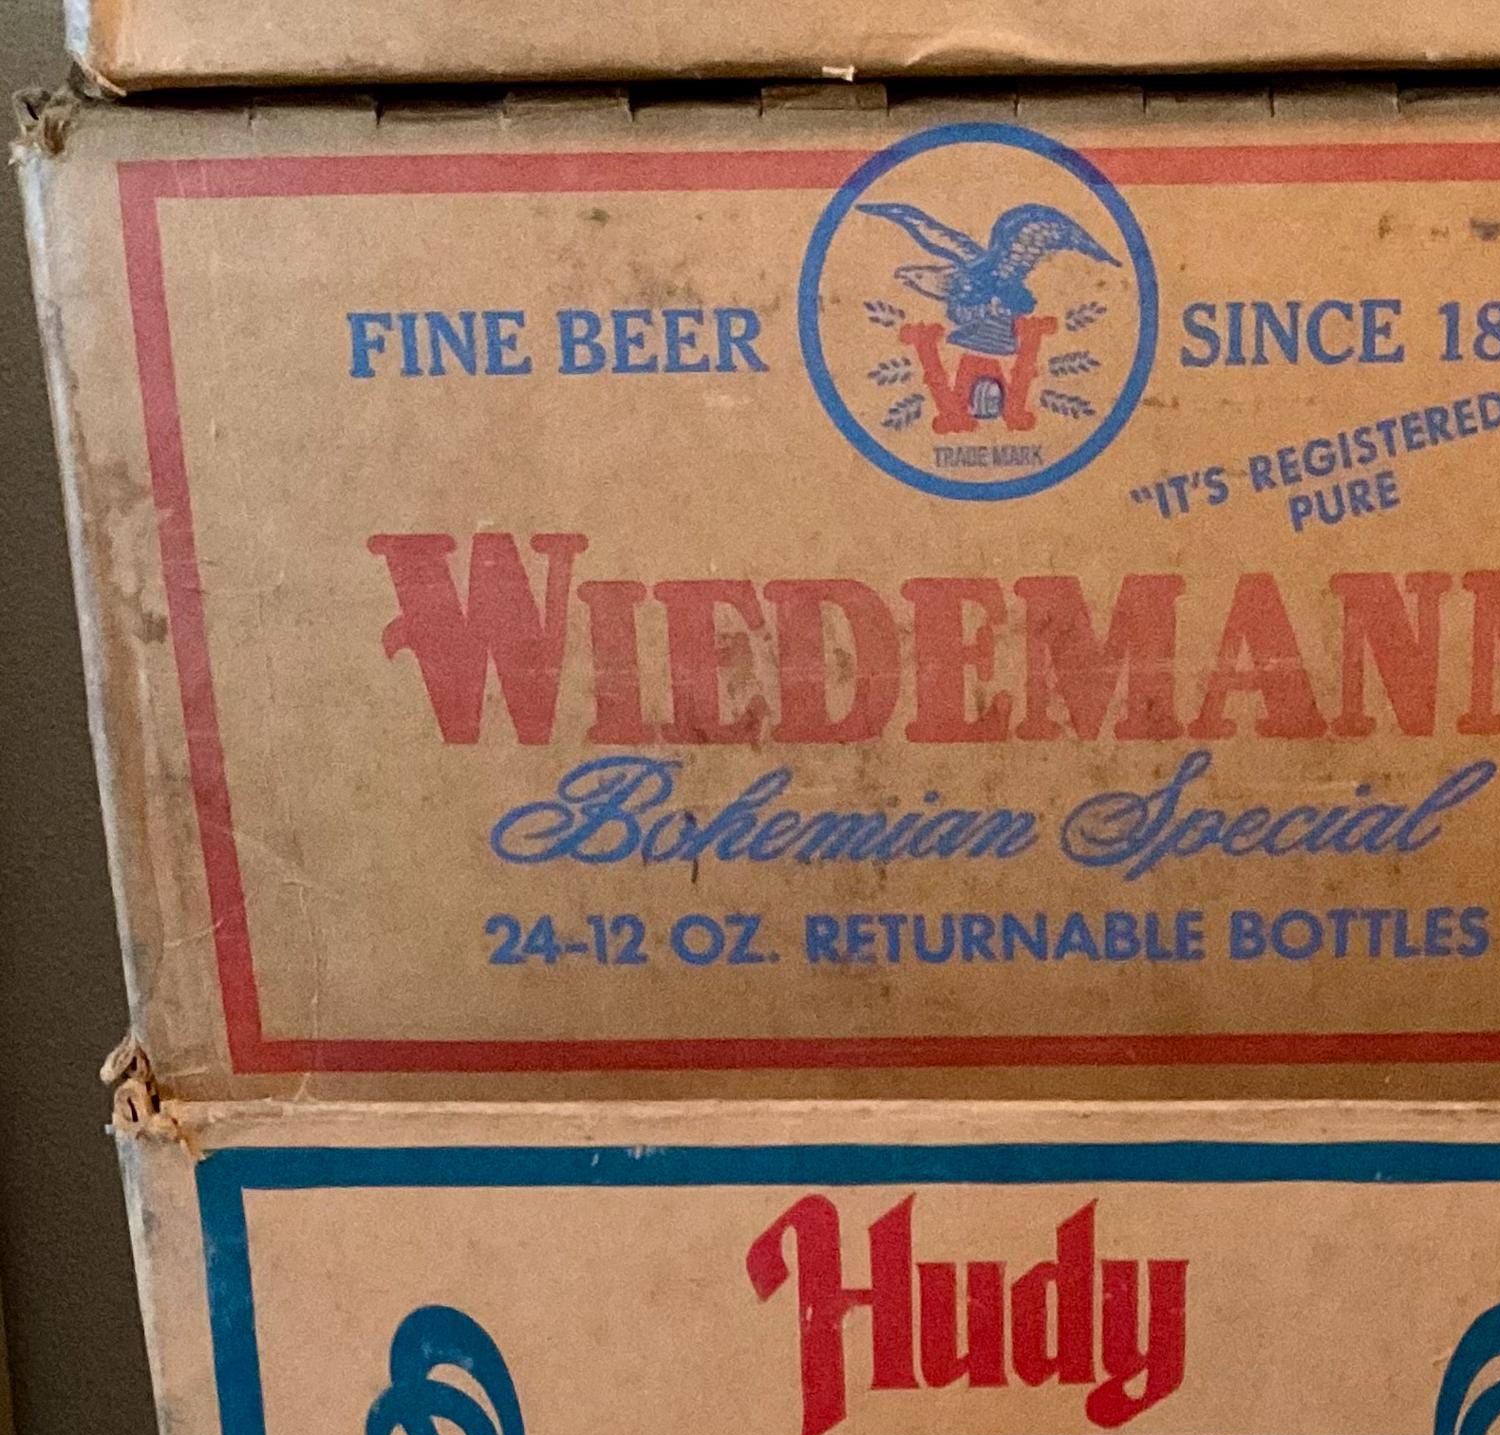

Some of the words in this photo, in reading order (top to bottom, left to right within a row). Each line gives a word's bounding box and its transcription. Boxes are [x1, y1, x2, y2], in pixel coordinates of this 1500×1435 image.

[346, 310, 532, 378] FINE
[559, 307, 770, 376] BEER
[1180, 299, 1406, 368] SINCE
[1289, 471, 1401, 532] PURE
[489, 755, 1037, 864] Bohemian
[1059, 750, 1497, 881] Special
[485, 913, 648, 965] 24-12
[670, 914, 780, 966] OZ.
[806, 910, 1205, 964] RETURNABLE
[1230, 907, 1491, 959] BOTTLES
